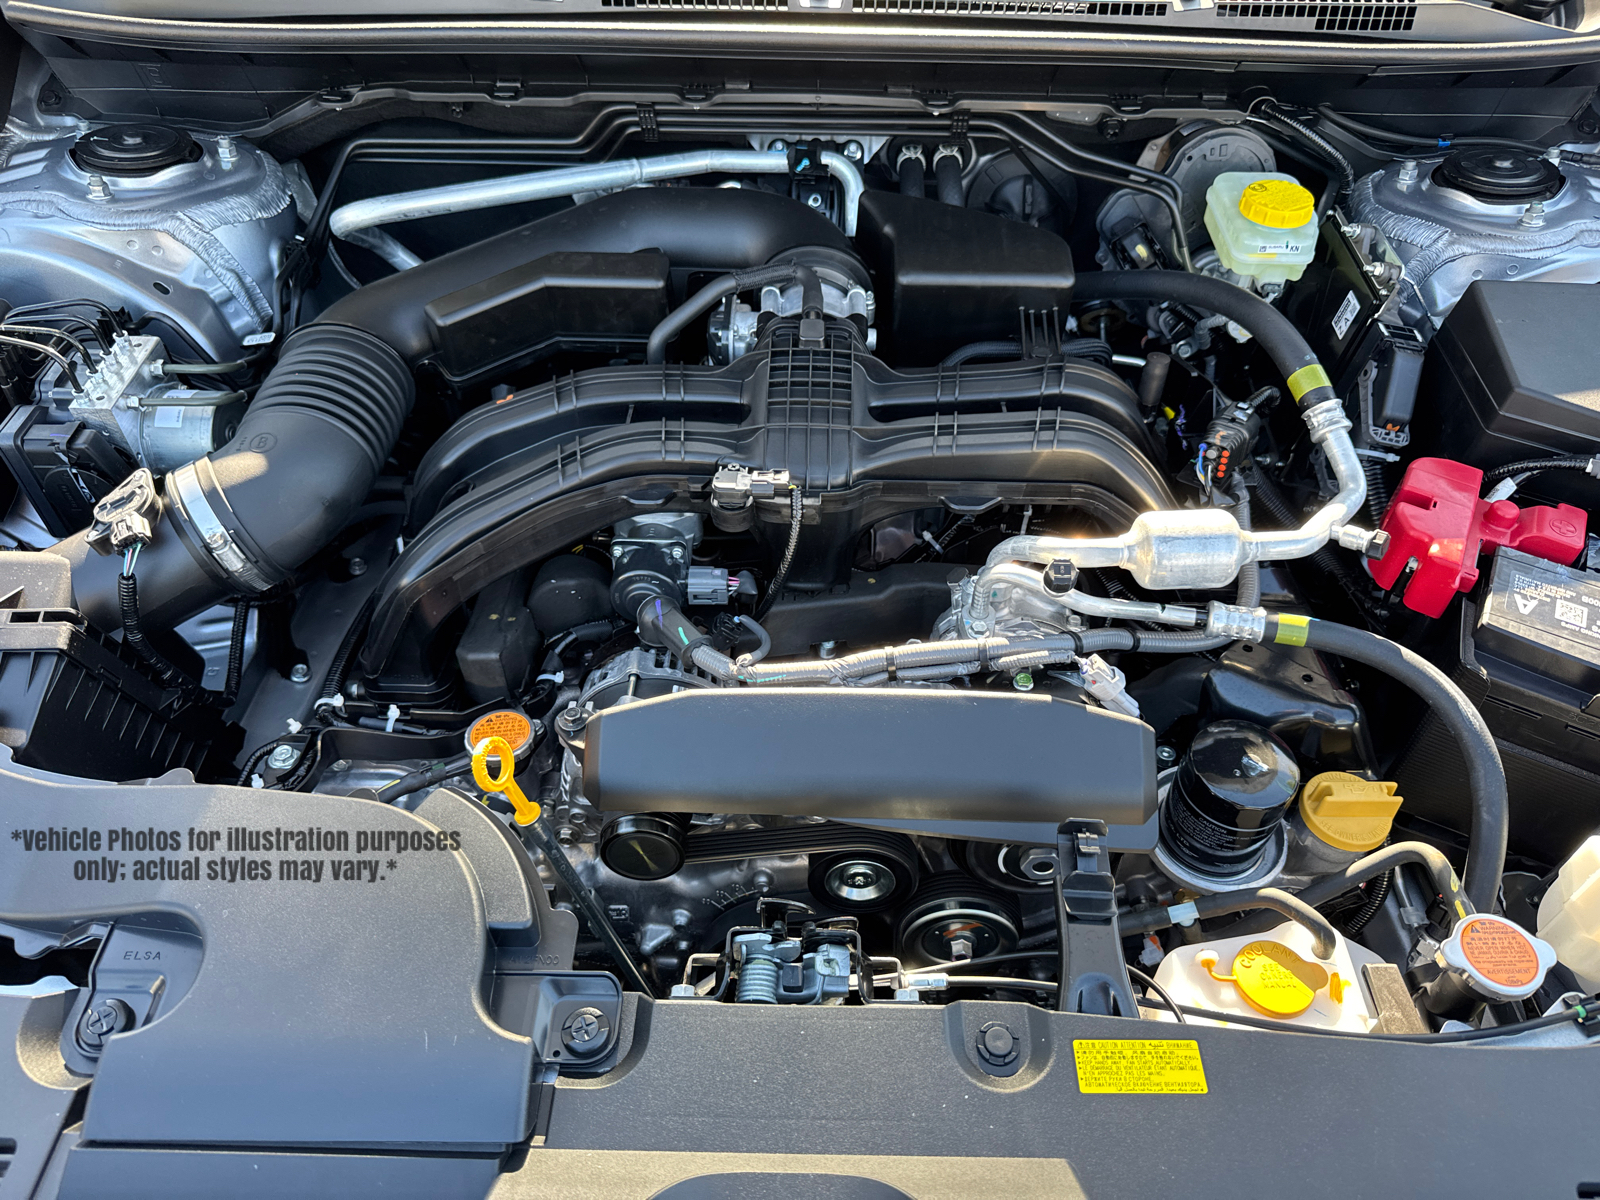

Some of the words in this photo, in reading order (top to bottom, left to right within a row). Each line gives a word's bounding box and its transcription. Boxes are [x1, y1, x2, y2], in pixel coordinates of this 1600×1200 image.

[1310, 773, 1347, 787] ENGINE
[1199, 817, 1227, 834] CAUTION
[1321, 820, 1333, 833] SEE
[1366, 820, 1389, 840] MANUAL
[123, 951, 161, 960] ELSA
[1240, 943, 1302, 969] COOLANT
[1262, 963, 1280, 971] SEE
